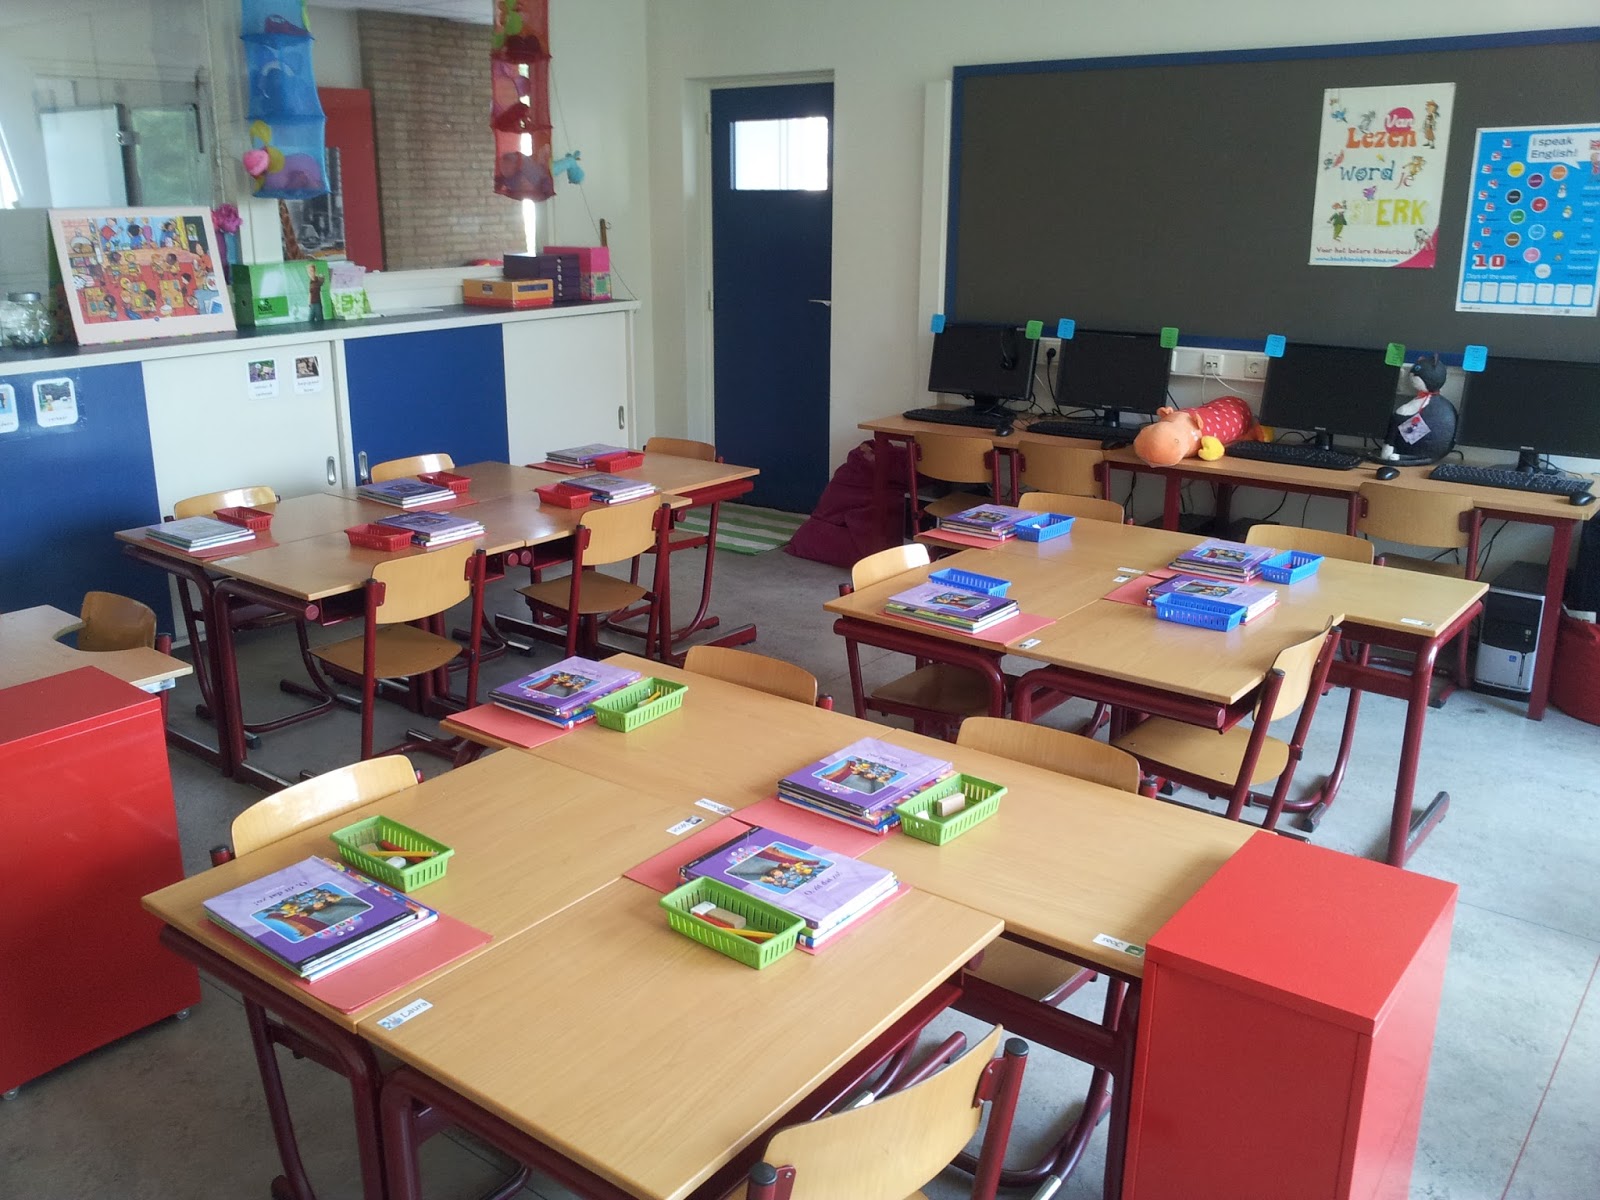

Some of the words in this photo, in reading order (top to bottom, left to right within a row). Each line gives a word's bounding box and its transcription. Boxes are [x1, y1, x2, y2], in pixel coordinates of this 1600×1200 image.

[1385, 114, 1416, 129] Van
[1346, 127, 1418, 149] Lezen
[1538, 136, 1574, 147] speak
[1531, 148, 1578, 160] English!
[1340, 160, 1395, 182] word
[1472, 253, 1506, 270] 10
[399, 1001, 428, 1021] Laura
